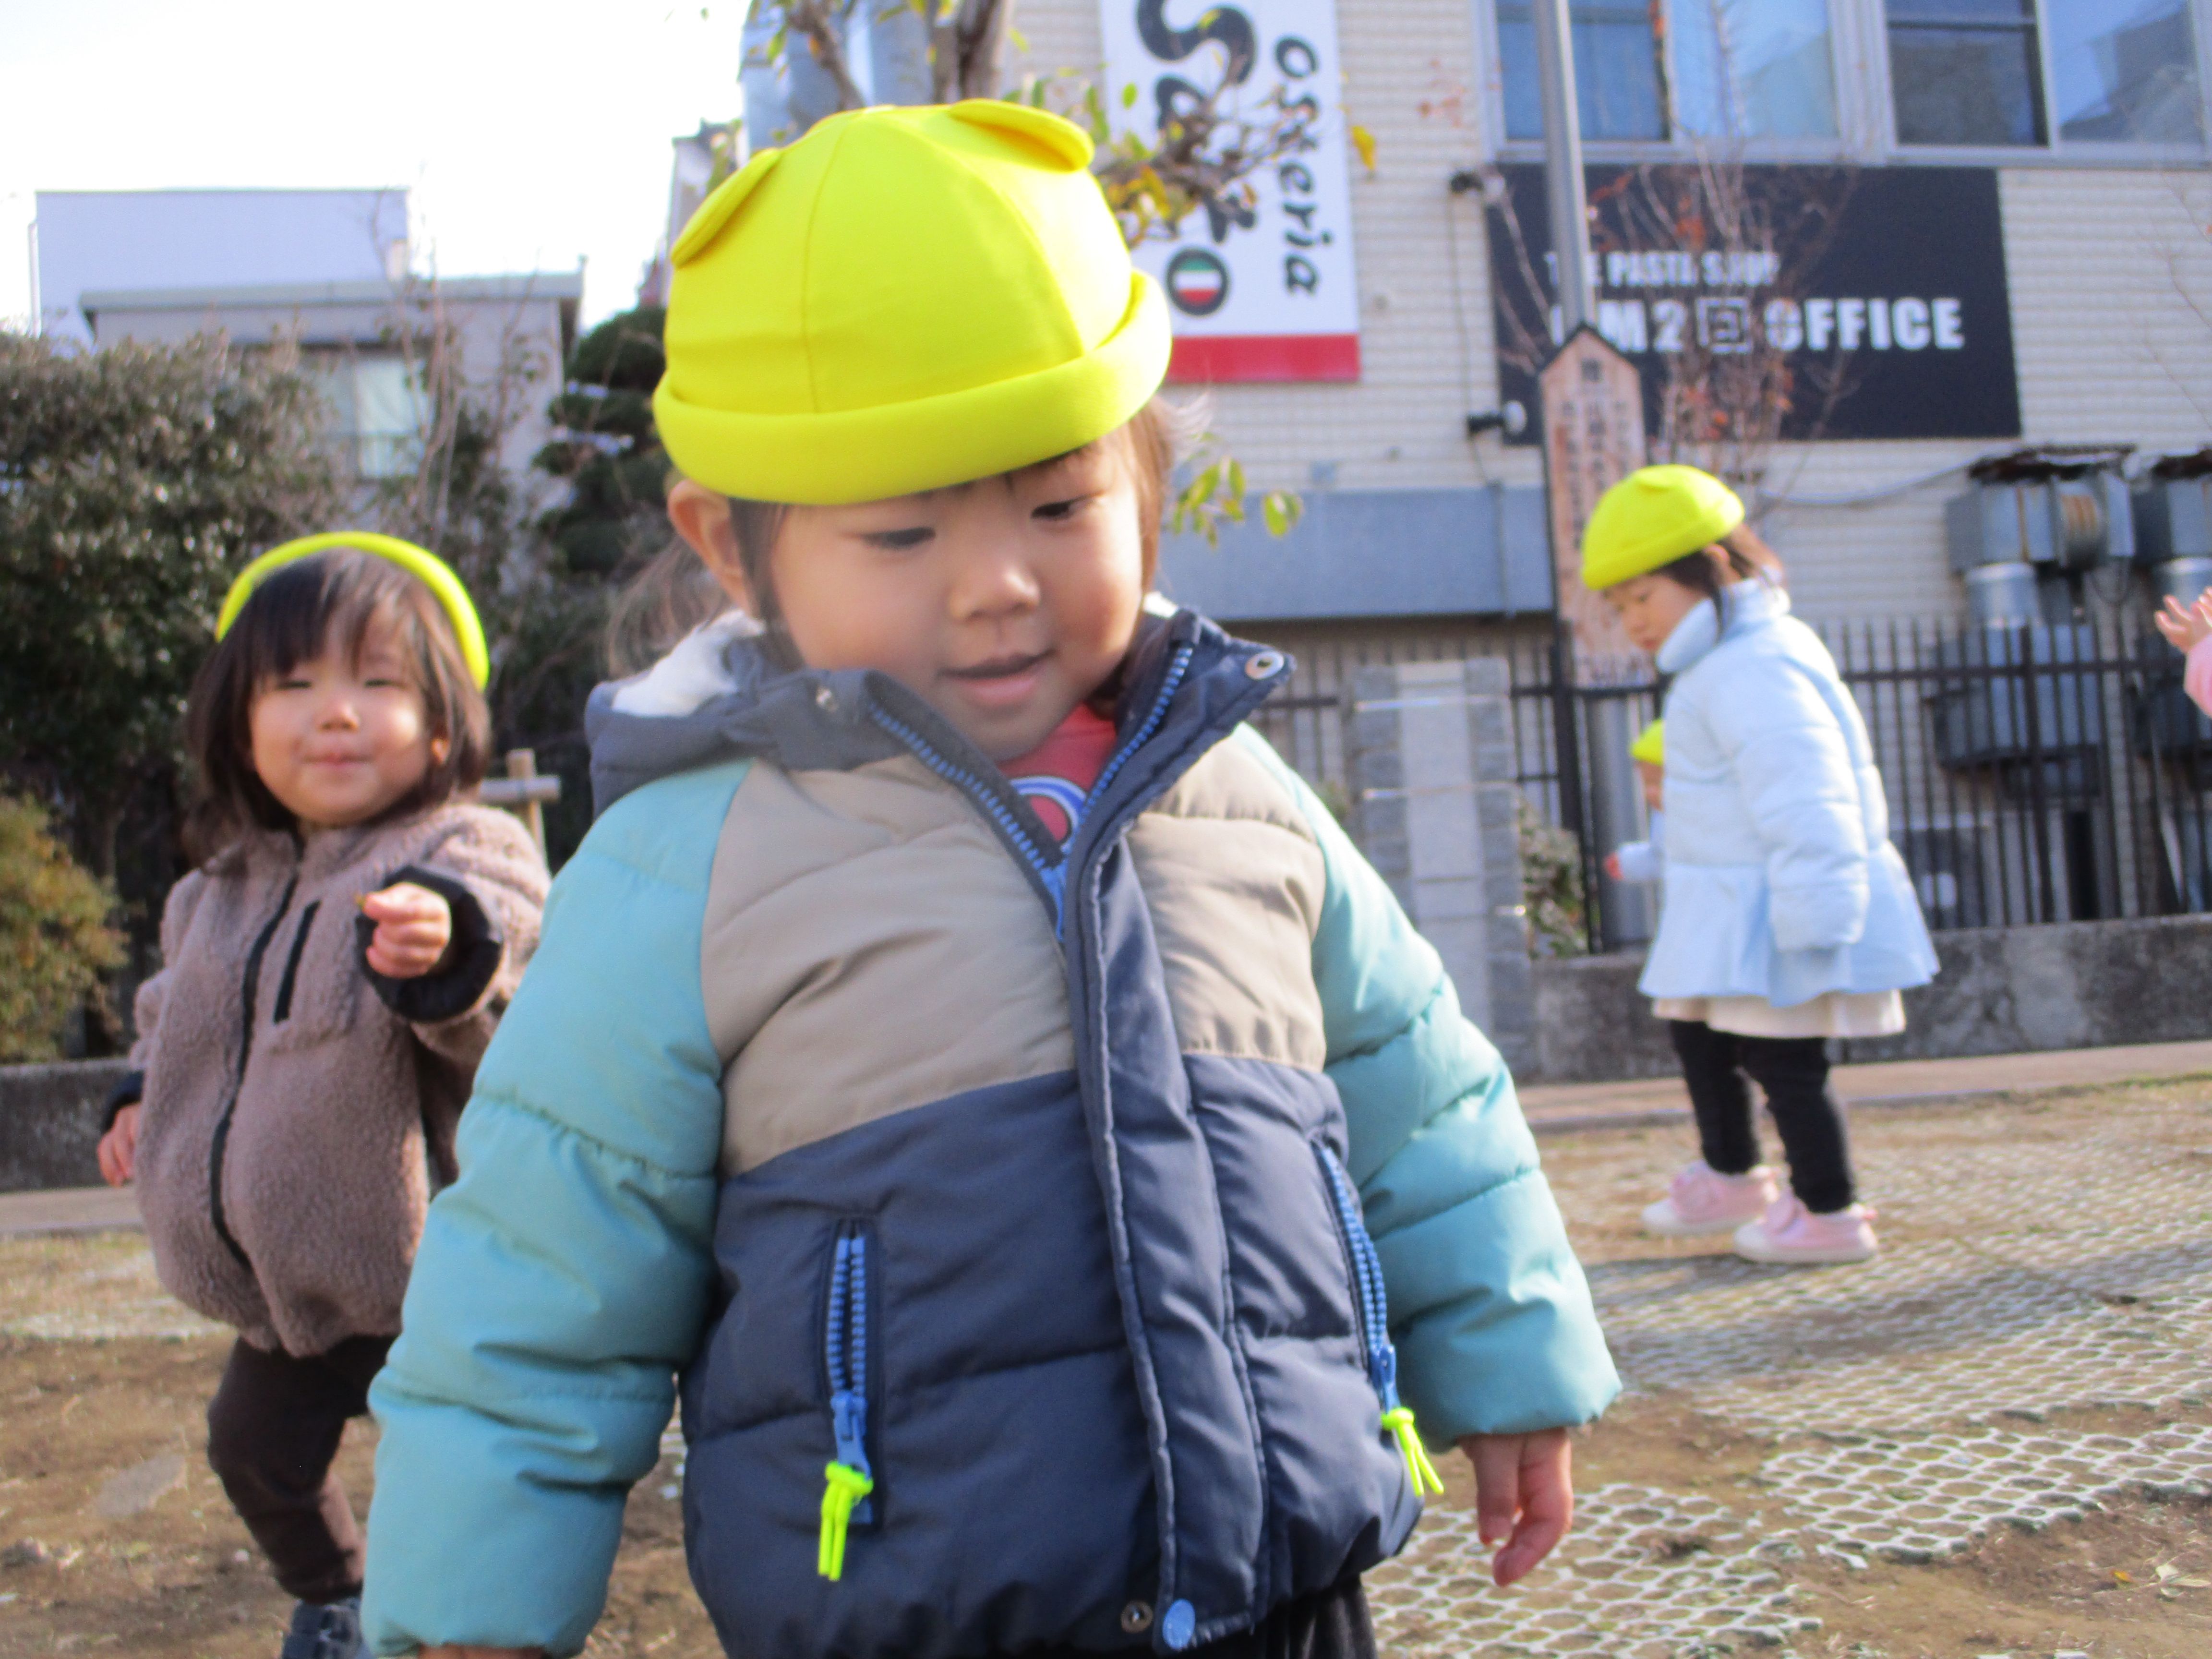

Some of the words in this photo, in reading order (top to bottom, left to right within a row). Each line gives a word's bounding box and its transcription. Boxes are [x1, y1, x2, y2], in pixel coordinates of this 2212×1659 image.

[1544, 251, 1601, 287] TE
[1607, 251, 1699, 287] PASTA
[1764, 296, 1965, 353] OFFICE
